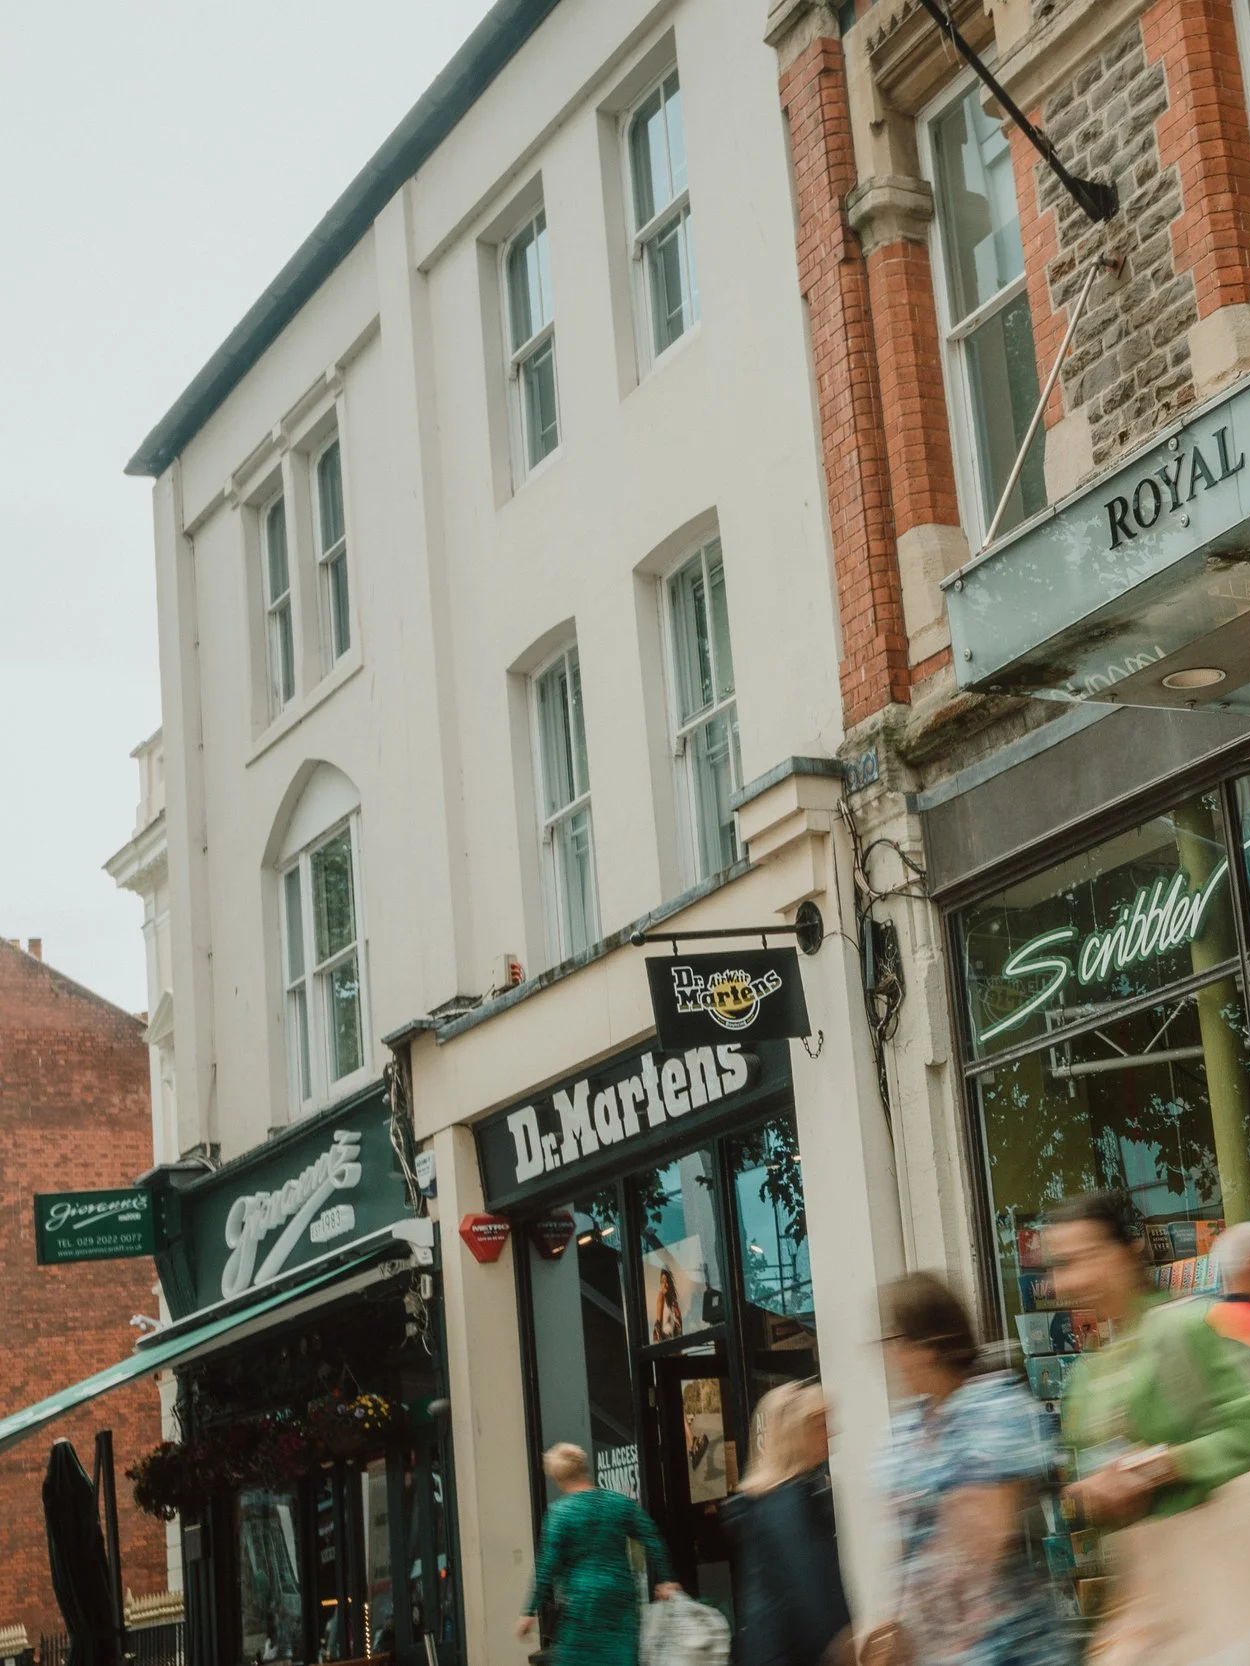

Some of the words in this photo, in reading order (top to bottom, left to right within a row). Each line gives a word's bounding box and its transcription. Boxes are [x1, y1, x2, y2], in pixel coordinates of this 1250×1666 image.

[1104, 426, 1246, 551] ROYAL
[675, 969, 782, 1013] Martens
[321, 1209, 341, 1232] 1983
[597, 1451, 616, 1471] ALL
